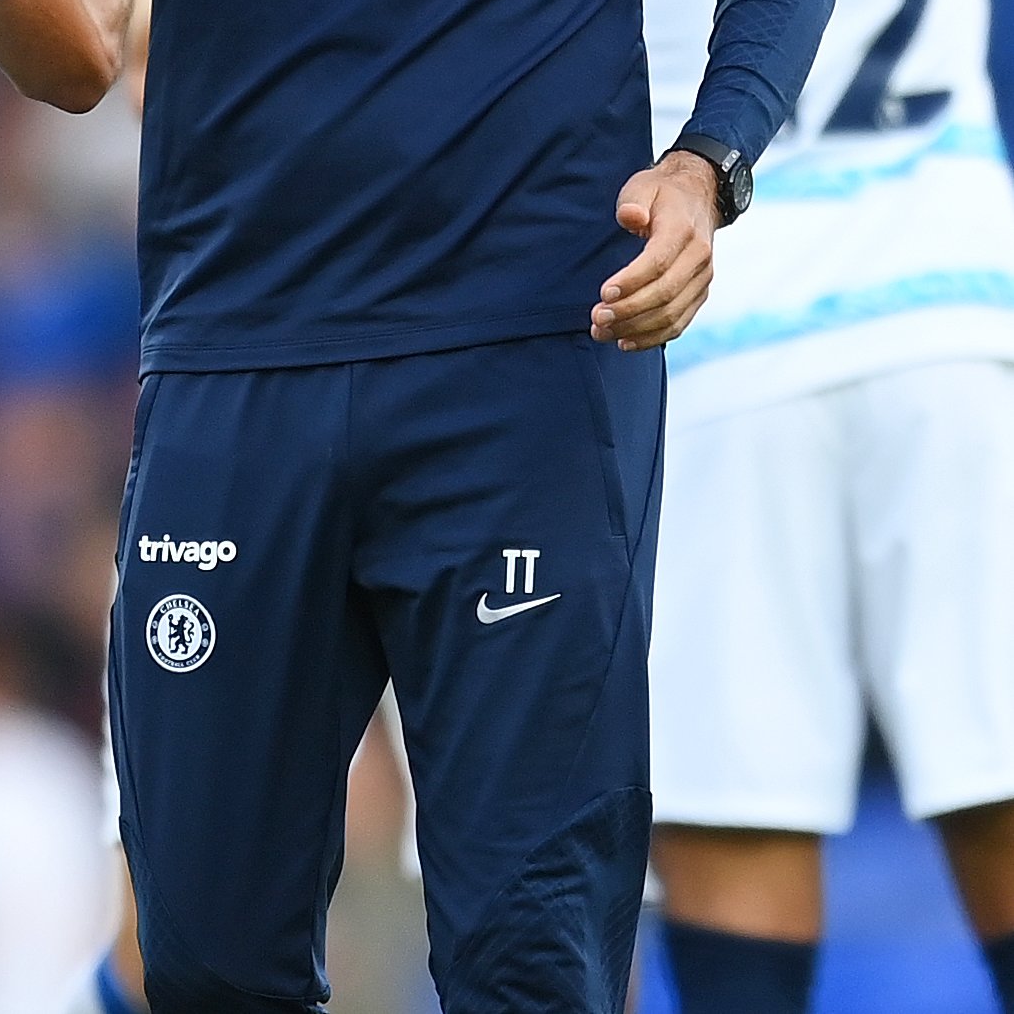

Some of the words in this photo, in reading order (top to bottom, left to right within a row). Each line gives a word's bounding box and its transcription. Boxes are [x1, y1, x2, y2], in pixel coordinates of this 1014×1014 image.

[138, 533, 237, 571] trivago
[502, 549, 541, 594] TT
[159, 599, 200, 617] CHELSEA
